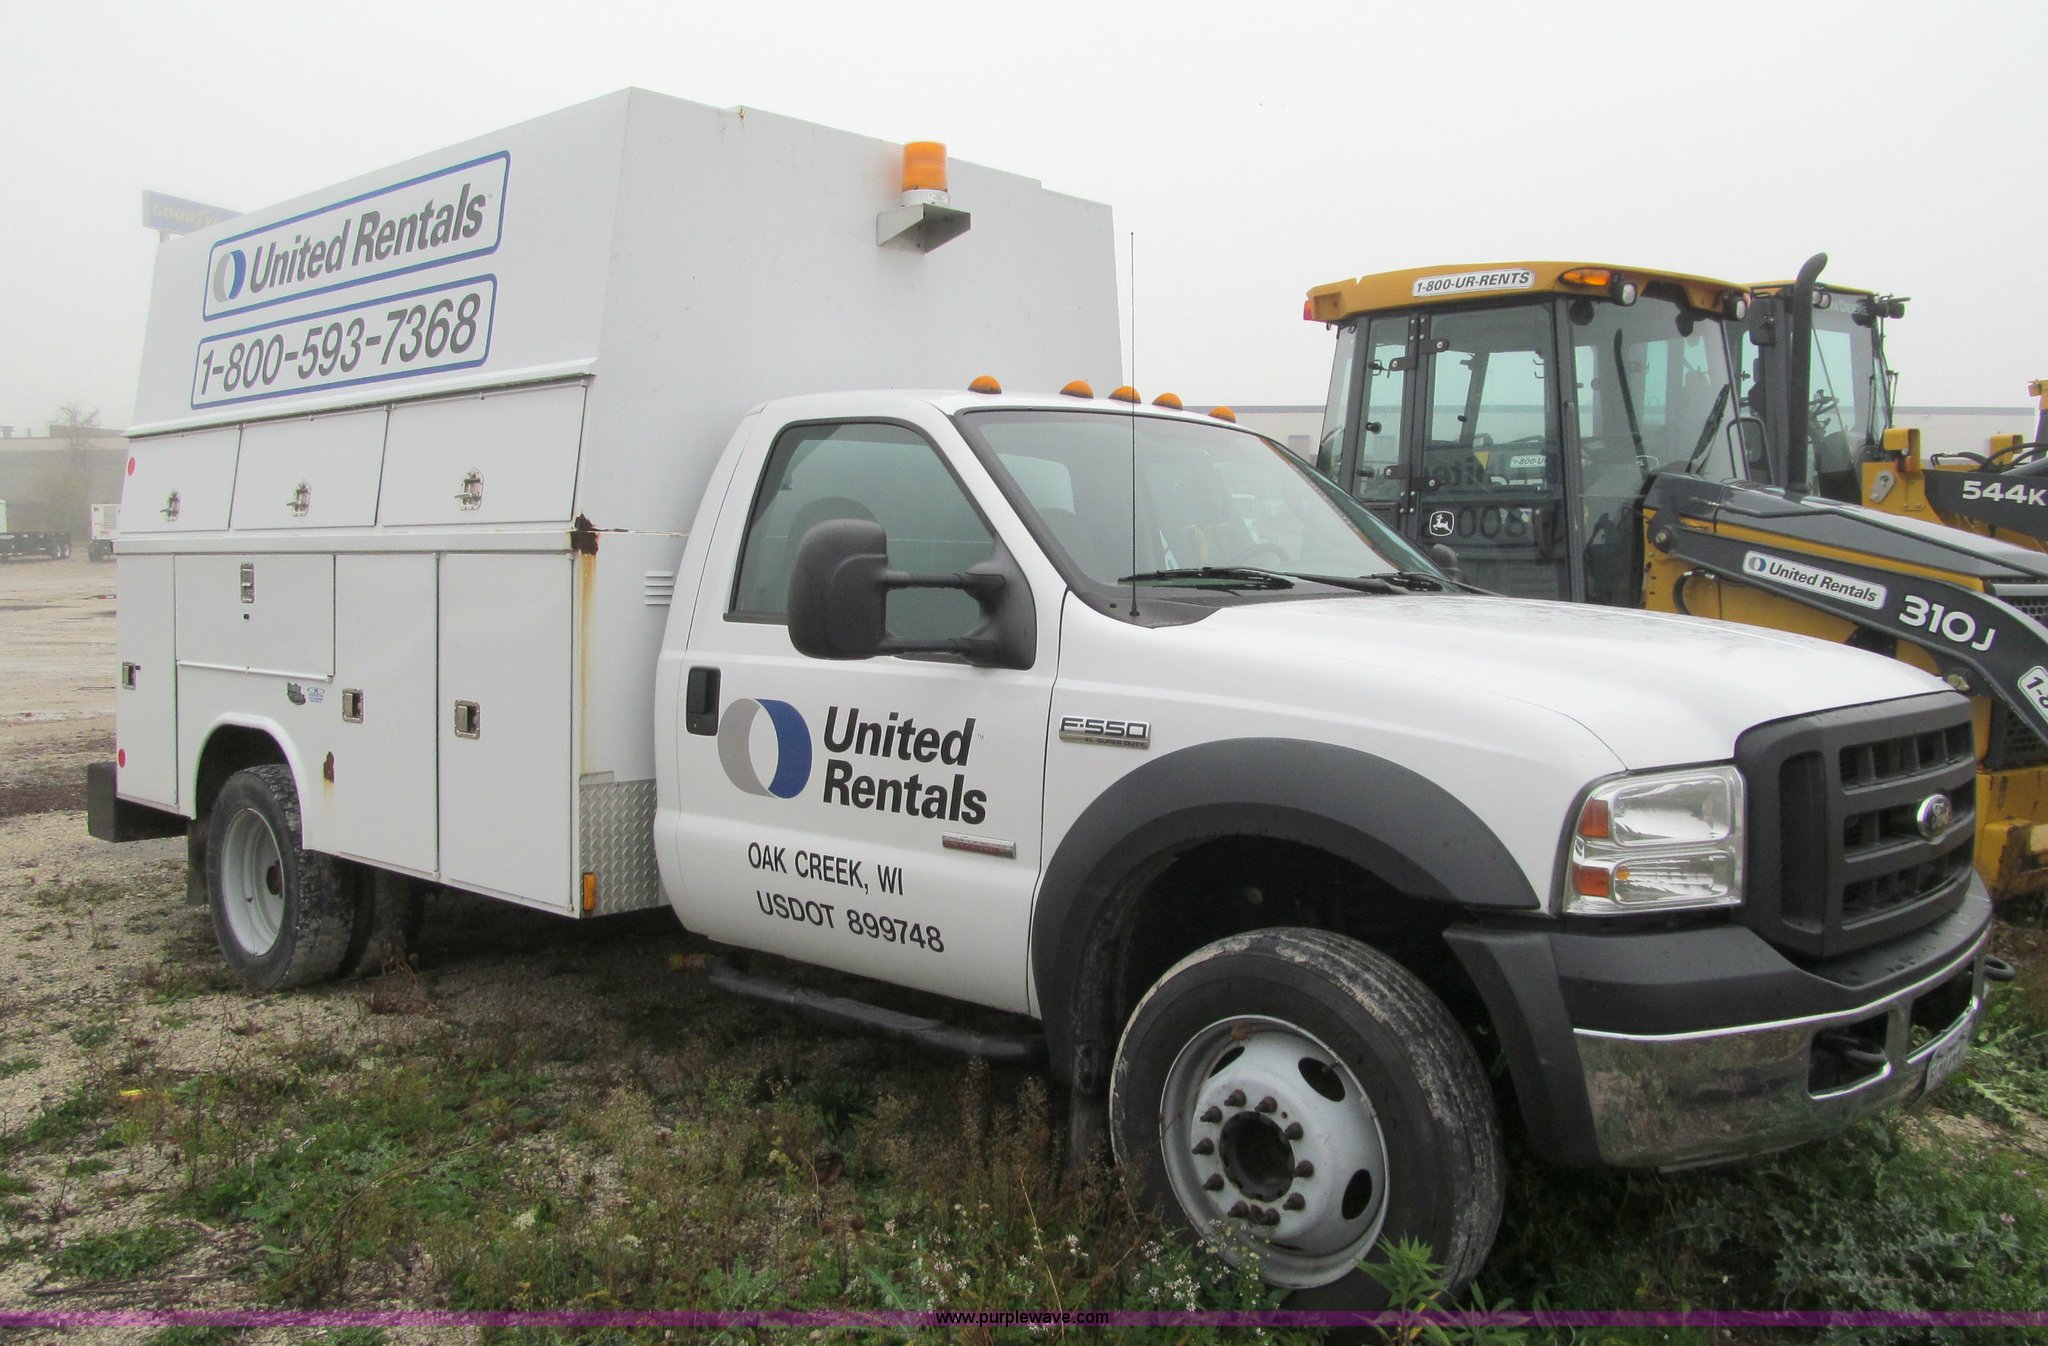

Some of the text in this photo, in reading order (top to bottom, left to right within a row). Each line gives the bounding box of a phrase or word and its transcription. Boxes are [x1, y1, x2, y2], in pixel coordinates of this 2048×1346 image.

[250, 183, 486, 294] United Rentals
[1417, 272, 1530, 293] 1-800-UR-RENTS
[201, 293, 481, 395] 1-800-593-7368
[1513, 457, 1547, 465] 1-800-U
[1962, 480, 2047, 506] 544K
[1768, 561, 1877, 602] United Rentals
[1899, 595, 1996, 651] 310J
[824, 706, 976, 766] United
[823, 759, 987, 825] Rentals
[748, 842, 904, 895] OAK CREEK, WI
[756, 890, 945, 953] USDOT 899748
